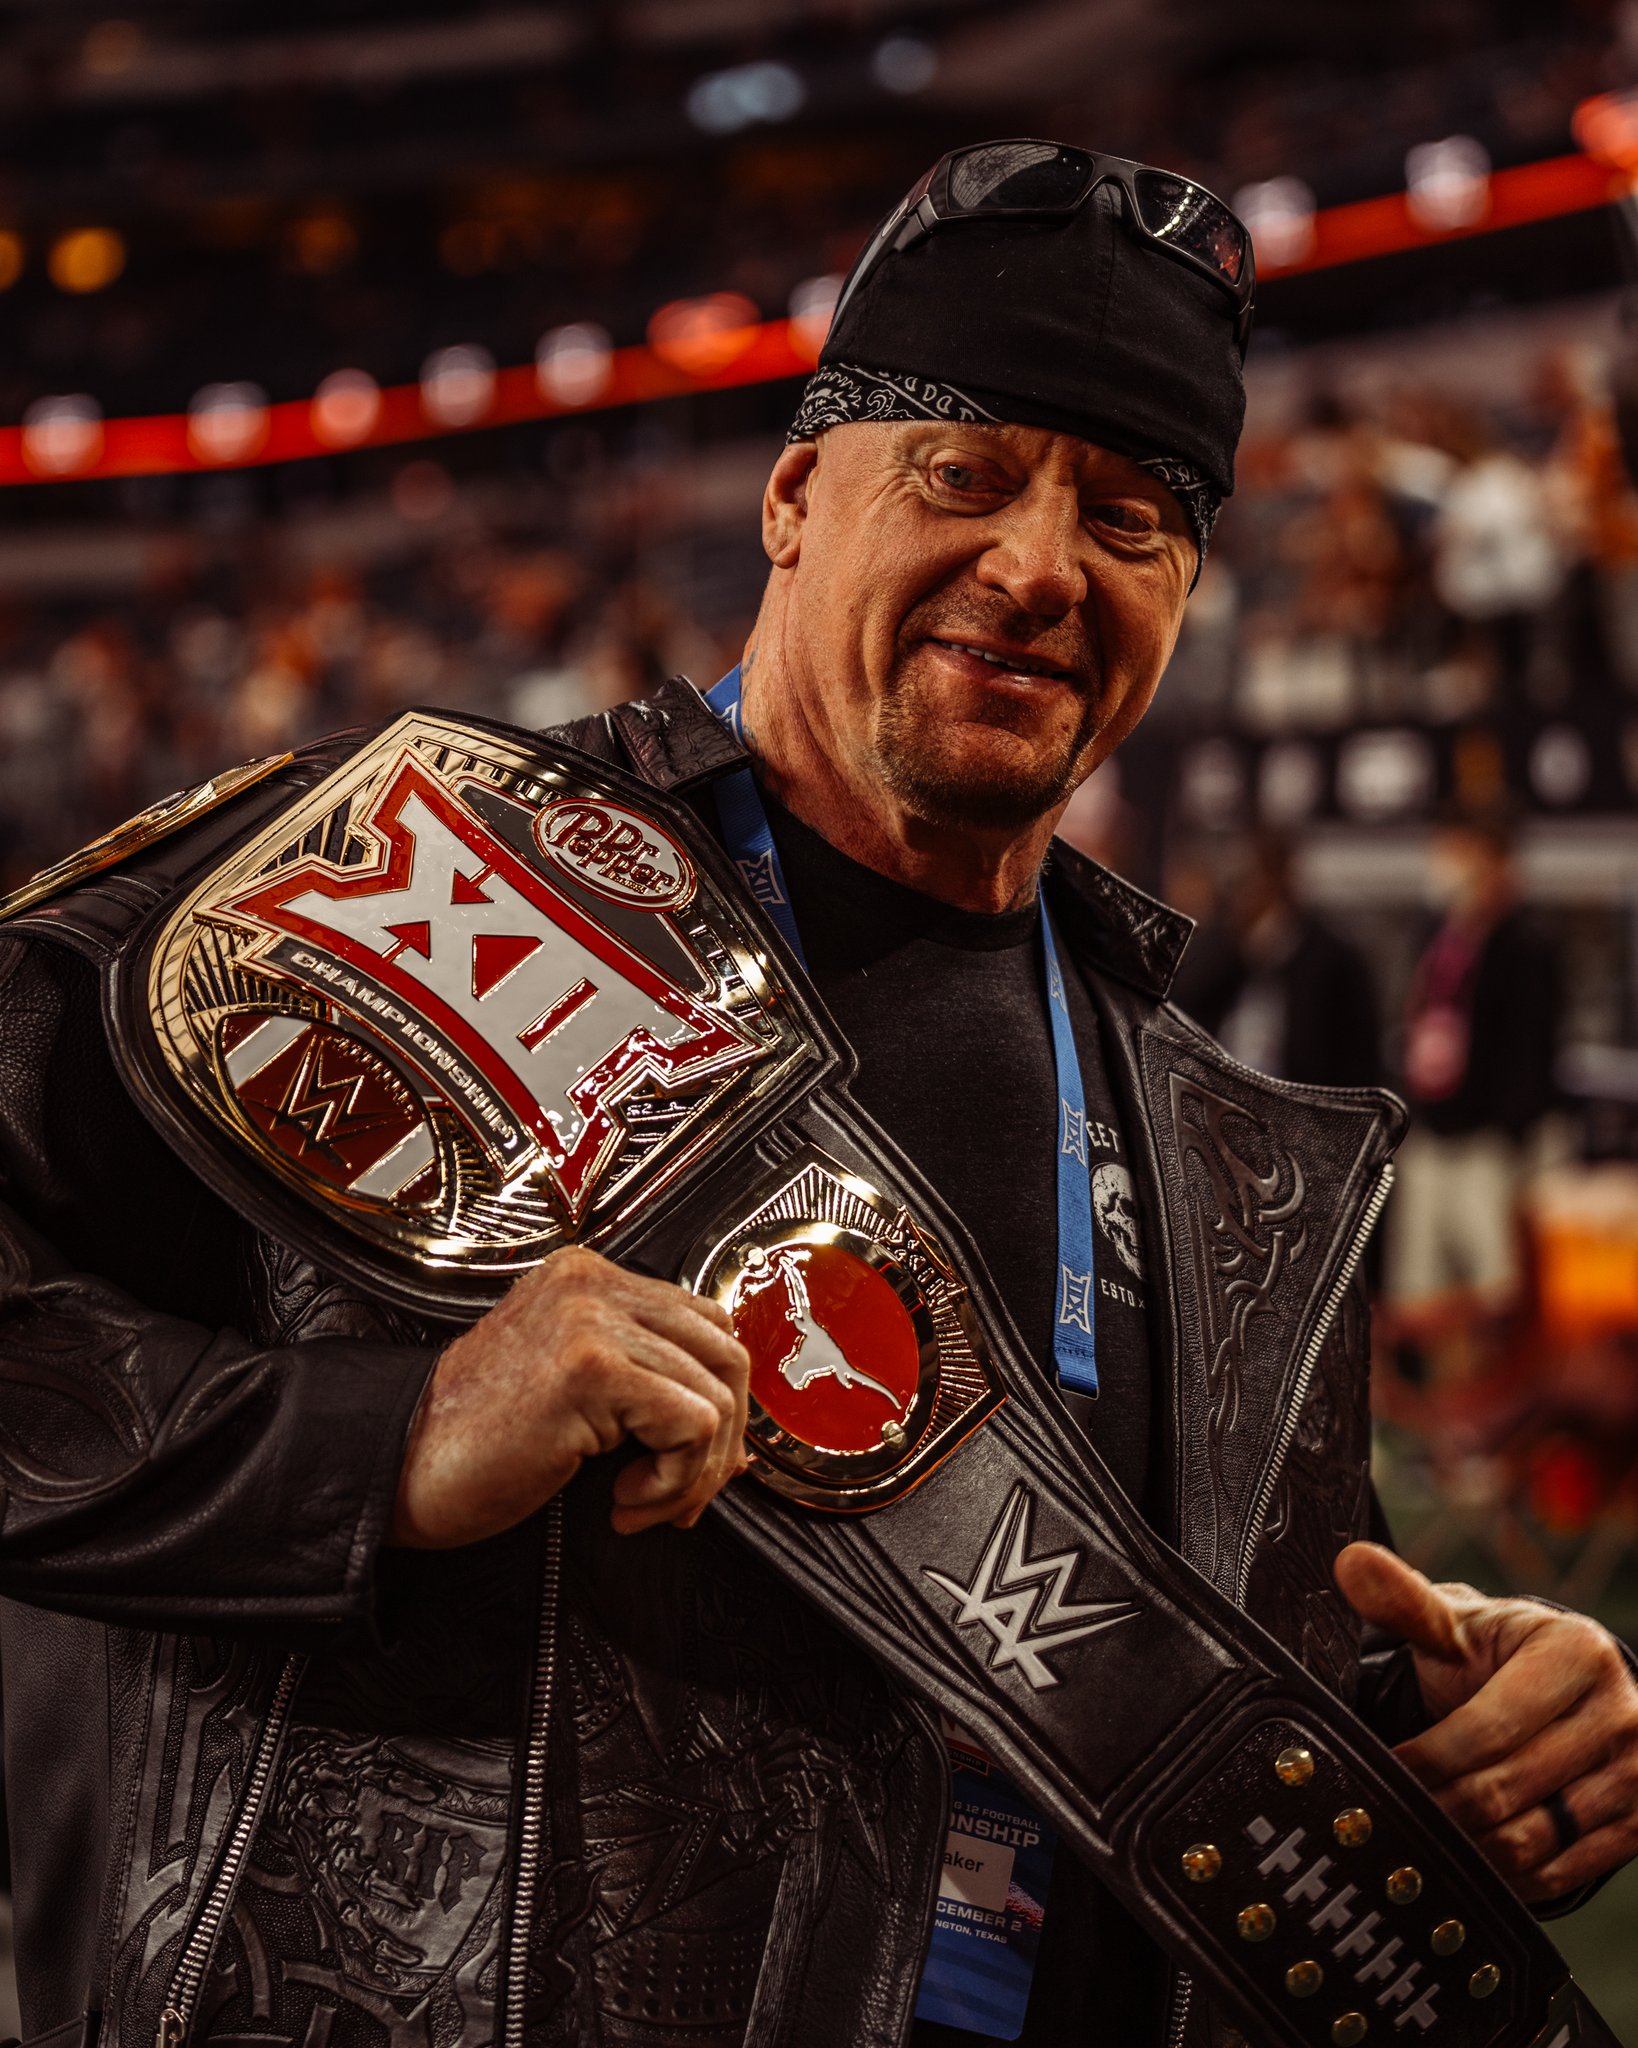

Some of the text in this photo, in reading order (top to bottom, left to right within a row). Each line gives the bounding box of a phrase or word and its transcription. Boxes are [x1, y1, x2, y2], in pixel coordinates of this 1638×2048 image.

[545, 805, 676, 893] Pepper
[600, 819, 660, 860] Dr
[966, 1804, 980, 1815] 12
[982, 1808, 1041, 1831] FOOTBALL
[936, 1900, 1023, 1932] CEMBER 2
[975, 1929, 1008, 1944] TEXAS
